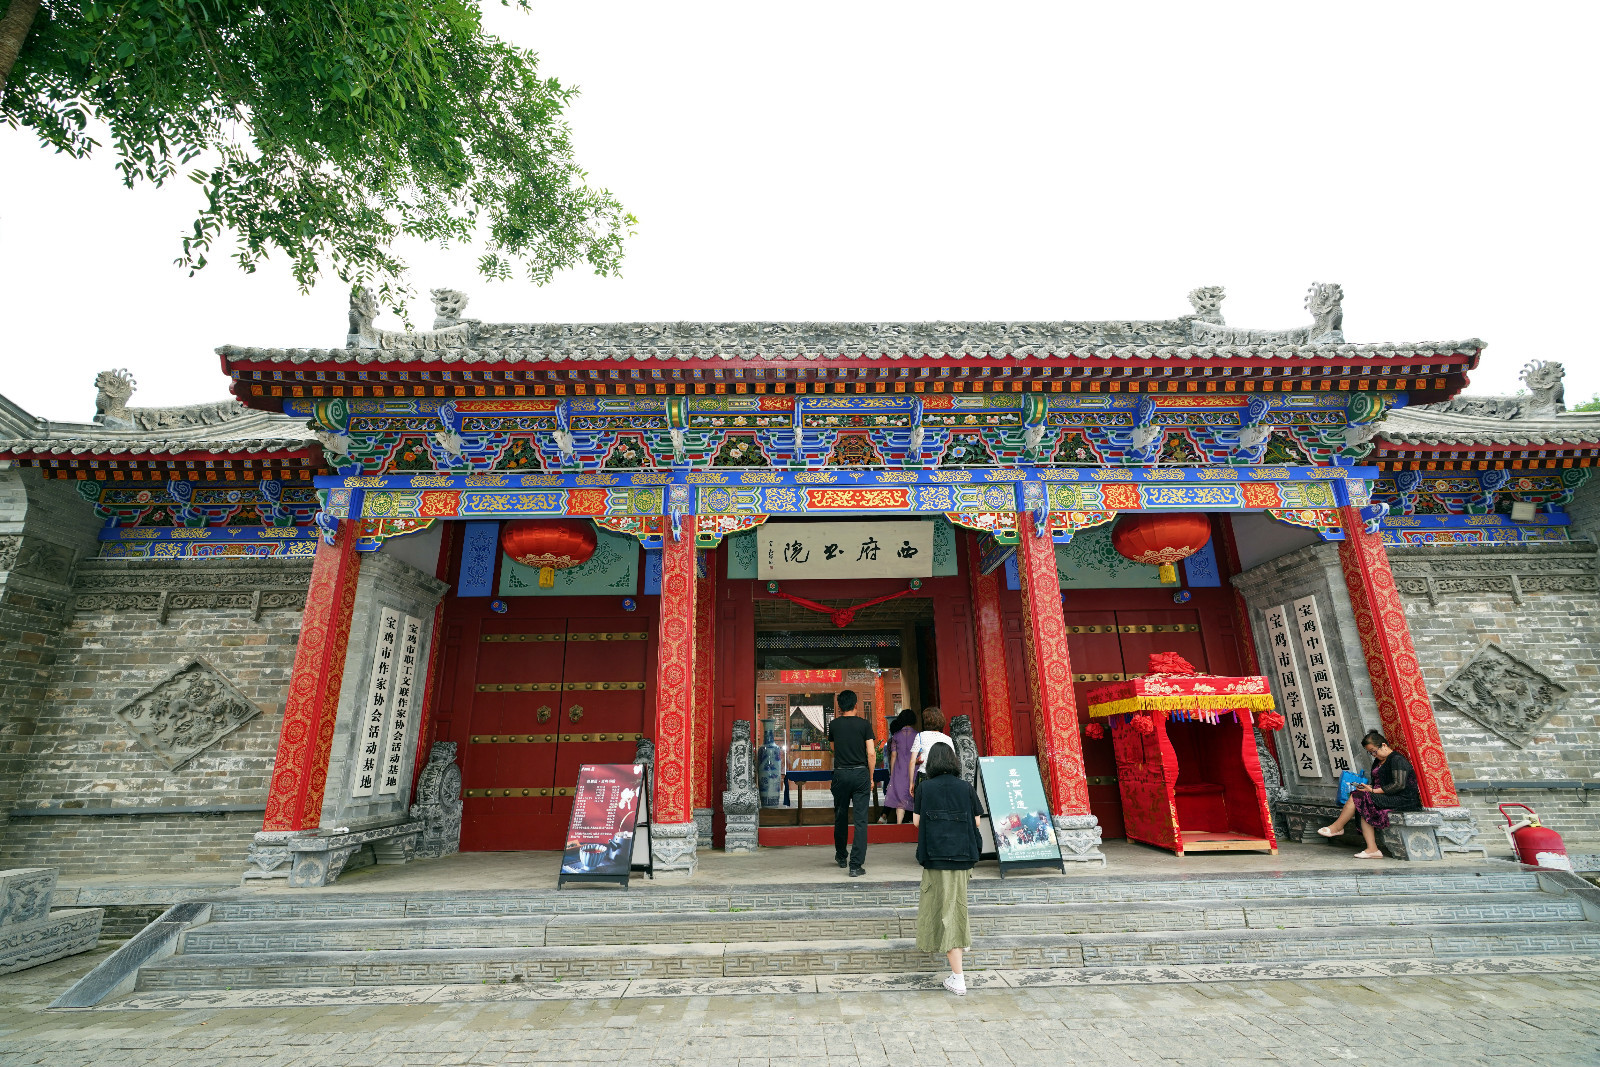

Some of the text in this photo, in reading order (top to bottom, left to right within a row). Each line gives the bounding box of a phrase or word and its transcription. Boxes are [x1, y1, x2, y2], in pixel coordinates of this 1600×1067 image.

[359, 615, 397, 789] 宝鸡市作家协会活动基地
[385, 623, 419, 787] 宝鸡市职工文联作家协会活动基地
[1269, 613, 1314, 771] 宝鸡市国学研究会
[1298, 603, 1350, 771] 宝鸡中国画院活动基地
